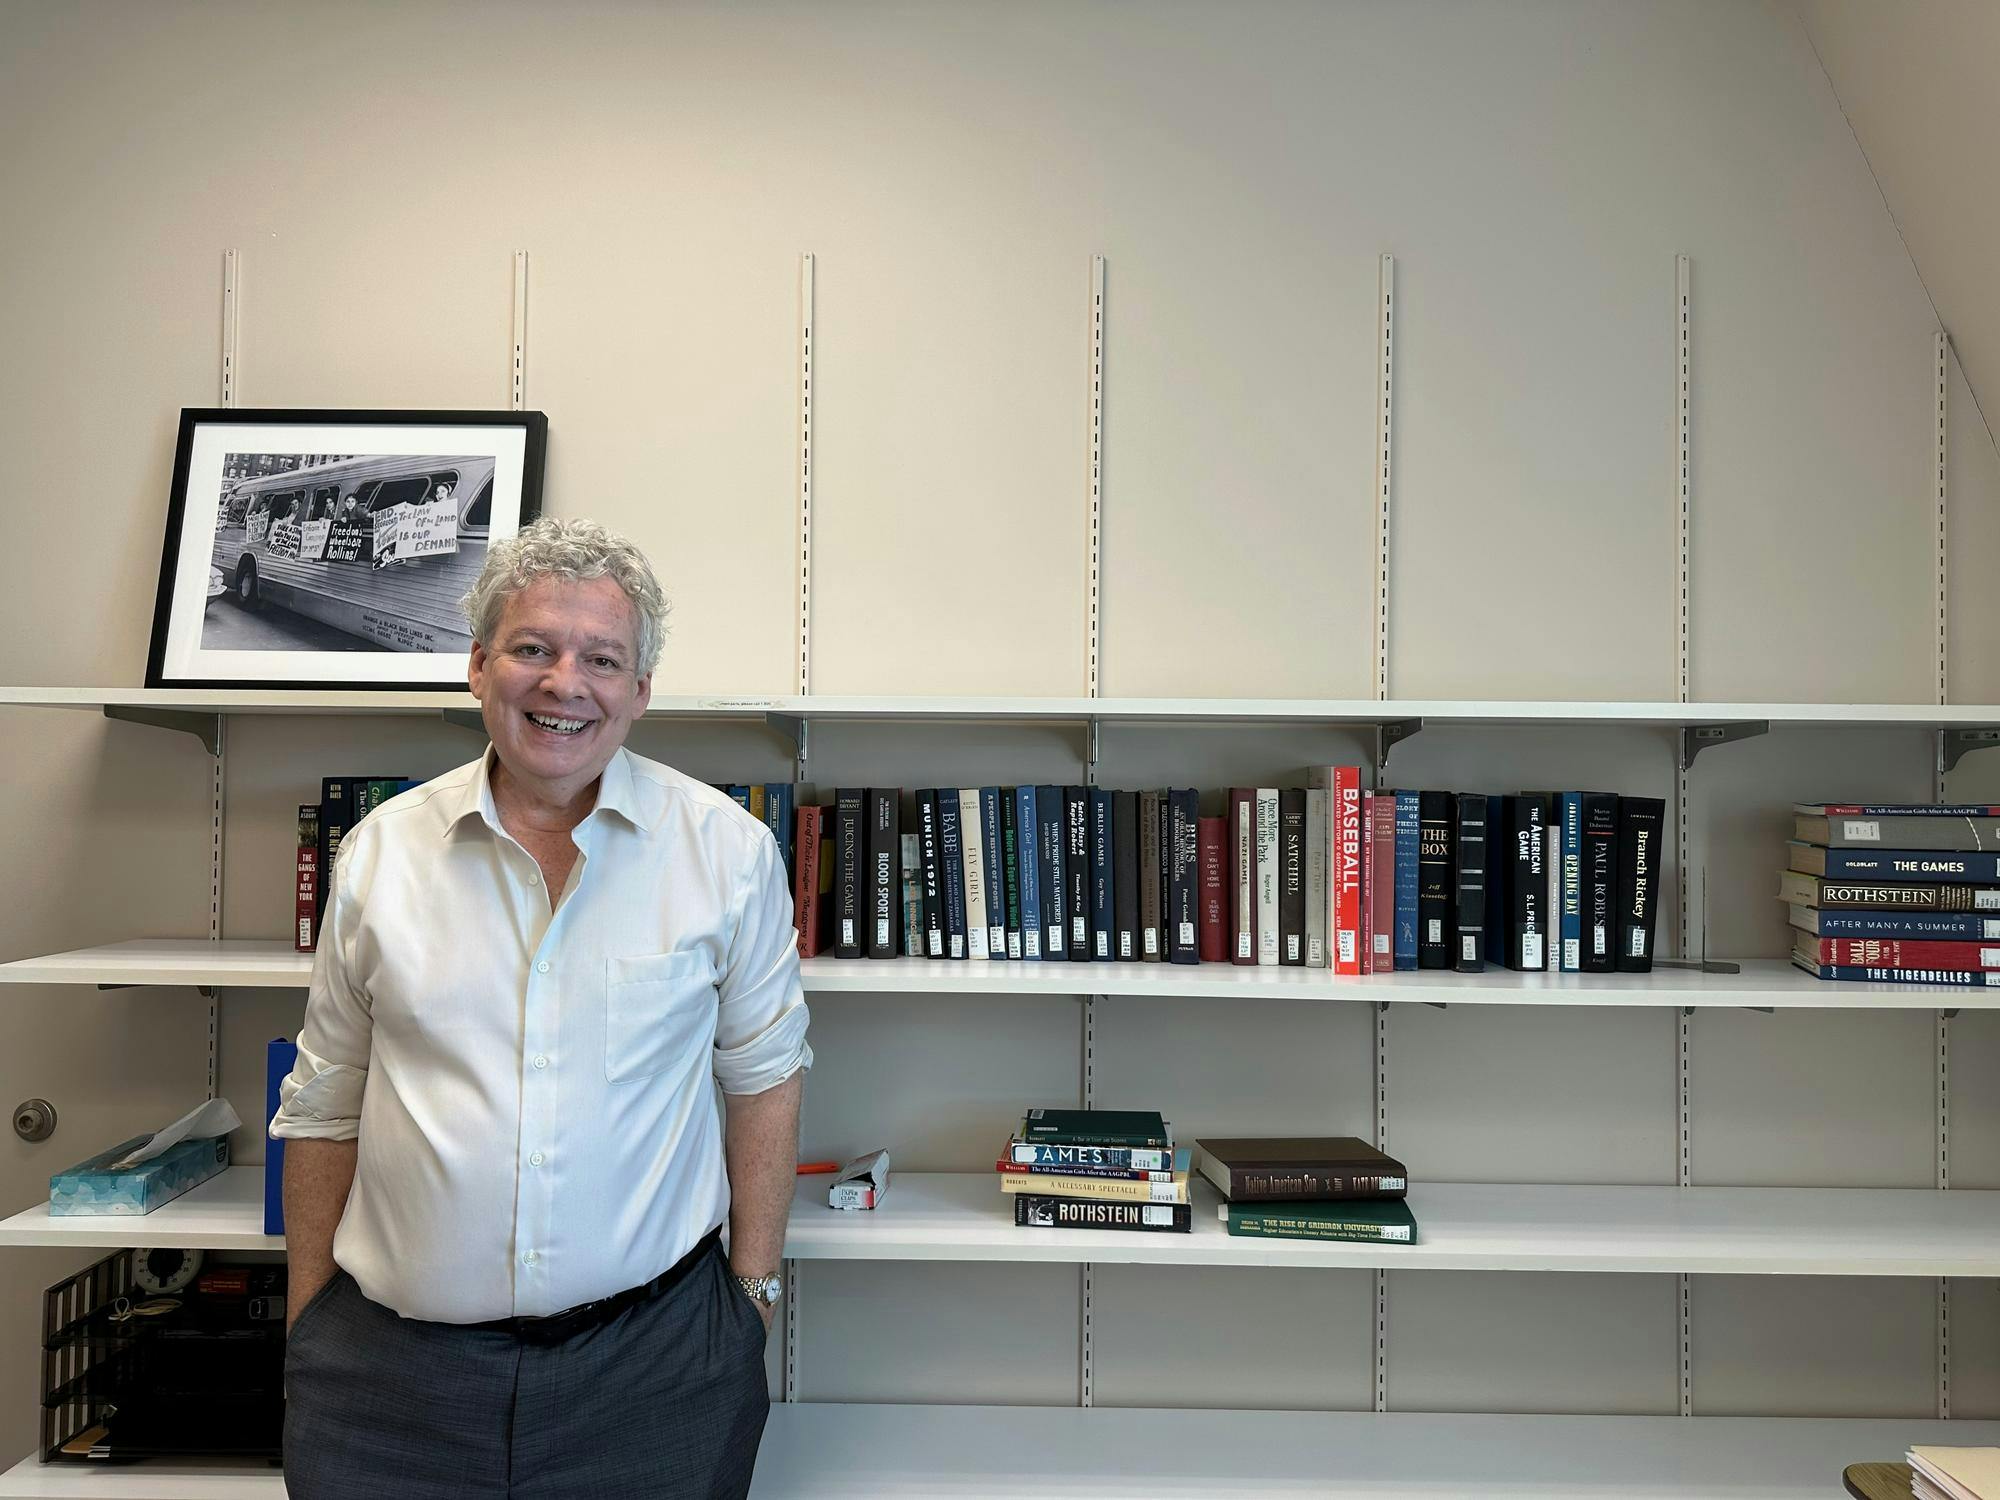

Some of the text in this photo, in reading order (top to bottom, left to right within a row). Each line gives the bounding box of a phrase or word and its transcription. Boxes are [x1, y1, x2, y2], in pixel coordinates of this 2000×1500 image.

[413, 507, 432, 519] LAW
[416, 515, 457, 528] OF LAND
[399, 530, 431, 541] IS OUR
[415, 538, 457, 552] DEMAND
[327, 545, 359, 562] Rolling!
[1336, 771, 1342, 780] AN
[359, 789, 367, 805] The
[988, 801, 996, 837] PEOPLE'S
[1023, 805, 1032, 832] America's
[1180, 812, 1186, 822] AN
[1267, 798, 1278, 842] Once More
[1865, 807, 1876, 815] The
[1877, 807, 1913, 815] All-American
[1913, 807, 1927, 815] Girls
[329, 825, 341, 837] THE
[942, 812, 957, 854] BABE
[1051, 823, 1059, 844] WHEN
[1069, 801, 1078, 855] Rapid Robert
[1076, 800, 1086, 849] Satch, Dizzy
[1257, 798, 1268, 864] Around the Park
[1568, 802, 1577, 849] JONATHAN EIG
[843, 818, 856, 859] JUICING
[1006, 829, 1014, 851] Before
[1025, 833, 1033, 845] Girl
[1162, 838, 1169, 847] ON
[1186, 823, 1197, 864] BUMS
[1343, 788, 1358, 894] BASEBALL
[1421, 829, 1449, 841] THE
[923, 803, 936, 897] MUNICH 1972
[1097, 837, 1105, 867] GAMES
[1421, 844, 1449, 856] BOX
[1518, 830, 1530, 861] GAME
[1530, 824, 1544, 875] AMERICAN
[302, 853, 313, 862] THE
[1007, 853, 1015, 866] the
[1052, 845, 1060, 866] PRIDE
[1287, 834, 1299, 896] SATCHEL
[298, 863, 316, 872] GANGS
[843, 861, 856, 882] THE
[877, 852, 889, 884] BLOOD
[967, 847, 980, 903] FLY GIRLS
[992, 869, 998, 880] OF
[1006, 867, 1015, 881] Eyes
[1180, 866, 1186, 874] OF
[1632, 831, 1649, 919] Branch Rickey
[1893, 860, 1917, 871] THE
[1921, 861, 1965, 873] GAMES
[303, 873, 311, 881] OF
[1053, 867, 1061, 886] STILL
[1566, 853, 1579, 915] OPENING DAY
[1594, 842, 1607, 926] PAUL ROBES
[300, 882, 313, 891] NEW
[992, 881, 1000, 910] SPORTS
[1009, 882, 1016, 892] of
[1825, 888, 1935, 903] ROTHSTEIN
[299, 892, 313, 901] YORK
[844, 884, 856, 915] GAME
[877, 887, 889, 918] SPORT
[1009, 893, 1017, 905] the
[1053, 887, 1061, 924] MATTERED
[1264, 889, 1272, 904] Angell
[1010, 906, 1018, 928] World
[1527, 910, 1535, 934] PRICE
[1825, 919, 1966, 932] AFTER MANY A SUMMER
[1850, 940, 1865, 965] BALL
[1865, 940, 1881, 965] FOUR
[1866, 968, 1971, 984] THE TIGERBELLES
[1035, 1147, 1102, 1164] AMES
[1041, 1167, 1072, 1175] All-American
[1057, 1181, 1097, 1193] NECESSARY
[1098, 1185, 1138, 1195] SPECTACLE
[1244, 1174, 1318, 1194] Native American Son
[1058, 1204, 1139, 1224] ROTHSTEIN
[1263, 1218, 1279, 1227] THE
[1279, 1219, 1297, 1228] RISE
[1297, 1221, 1307, 1229] OF
[1308, 1221, 1342, 1231] GRIDIRON
[1343, 1223, 1382, 1233] UNIVERSIT
